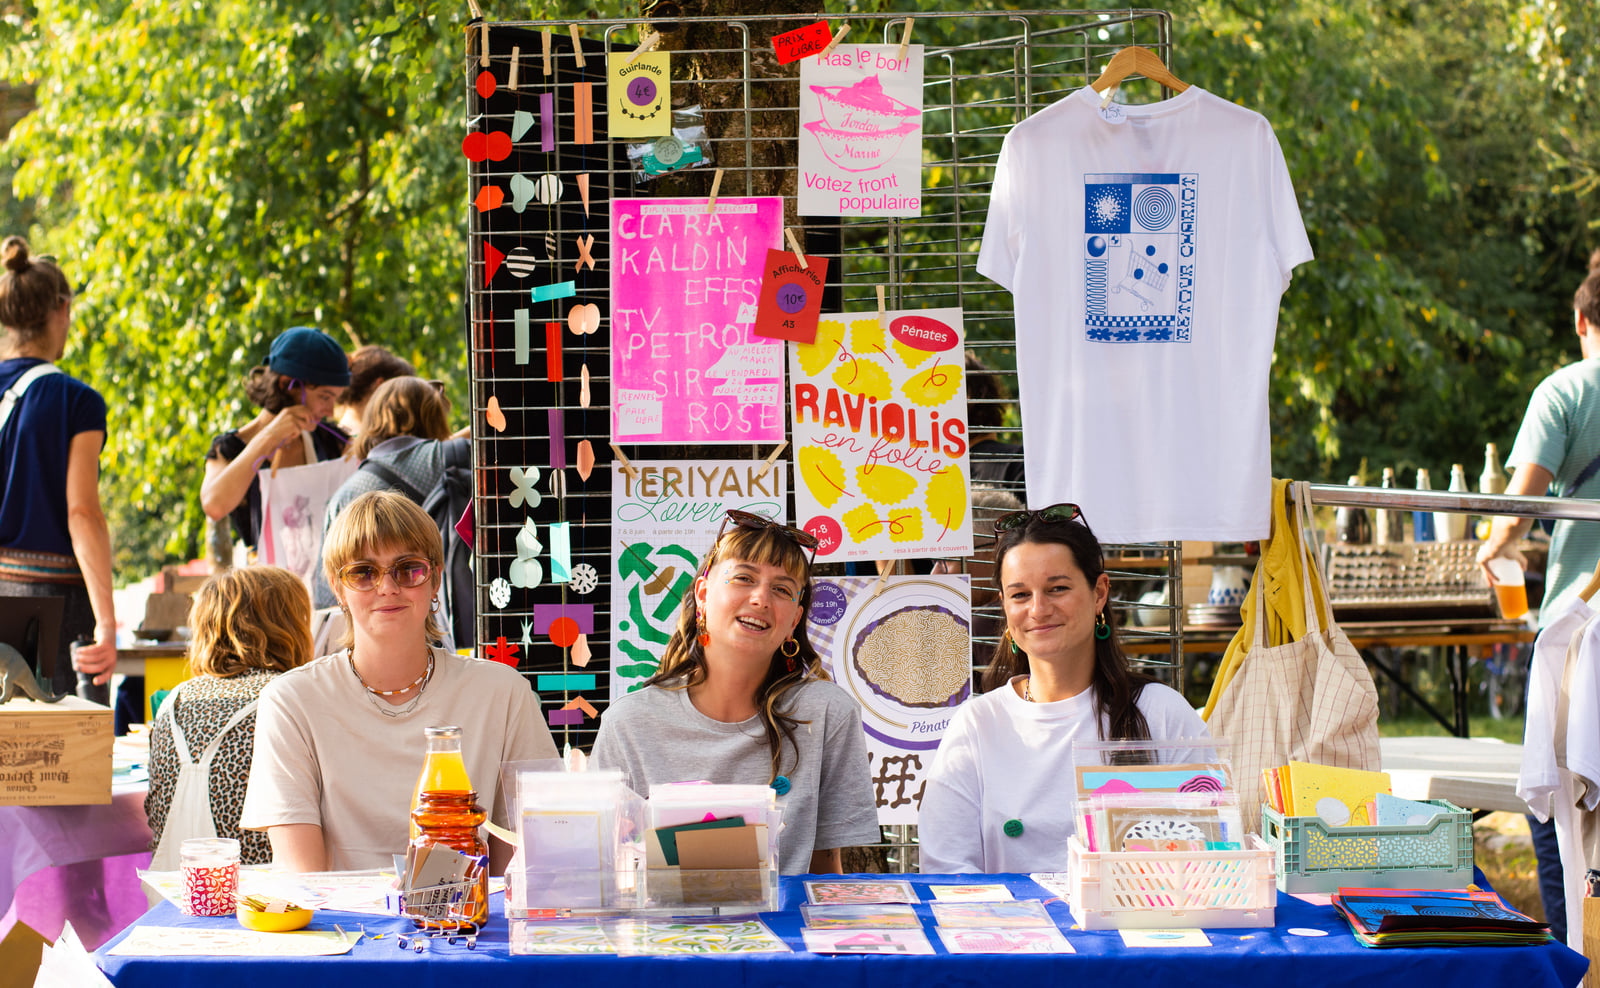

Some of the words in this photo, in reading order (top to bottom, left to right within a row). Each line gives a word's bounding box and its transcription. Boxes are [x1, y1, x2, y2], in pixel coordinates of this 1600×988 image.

[790, 39, 822, 57] LIBRE
[619, 62, 662, 77] Guirlande
[635, 84, 651, 98] 4€
[840, 111, 880, 132] Jordan
[804, 172, 852, 193] Votez
[858, 172, 899, 194] front
[839, 193, 920, 213] populaire
[1180, 176, 1196, 258] CHARIOT
[621, 236, 748, 276] KALDIN
[772, 263, 805, 279] Affiche
[806, 270, 822, 286] riso
[784, 293, 805, 305] 10€
[1176, 264, 1193, 341] RETOUR
[616, 306, 662, 331] TV
[782, 320, 795, 329] A3
[626, 322, 766, 360] PETROL
[901, 324, 948, 343] Pénates
[653, 368, 704, 398] SIR
[725, 368, 772, 378] VENDREDI
[621, 391, 655, 401] RENNES
[688, 402, 779, 434] ROSE
[811, 433, 864, 453] en
[863, 434, 949, 475] folie
[618, 465, 780, 498] TERIYAKI
[617, 475, 728, 522] Lover
[810, 524, 828, 537] 7-8
[817, 536, 835, 551] év.
[942, 544, 968, 552] couverts
